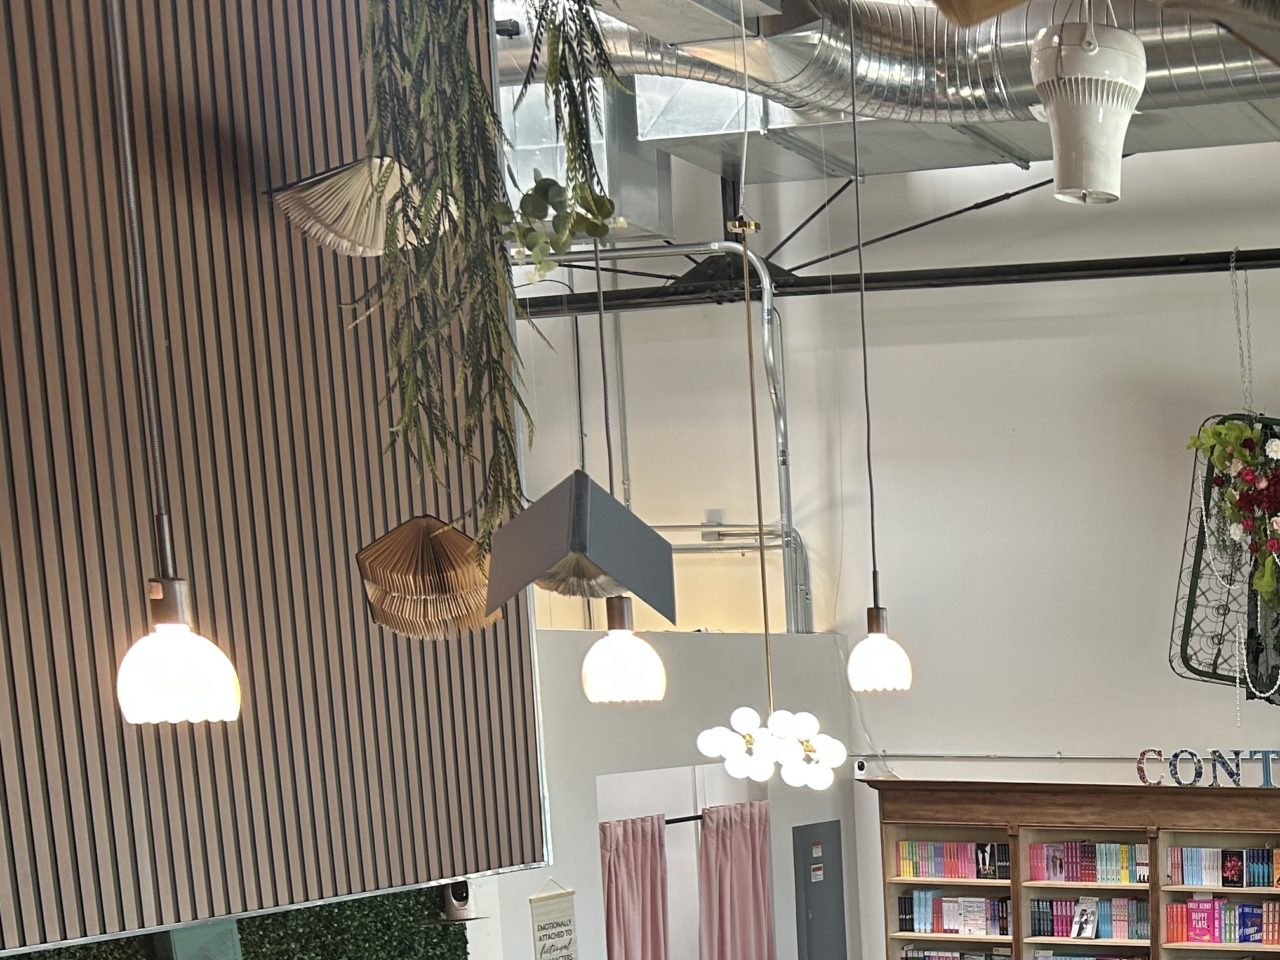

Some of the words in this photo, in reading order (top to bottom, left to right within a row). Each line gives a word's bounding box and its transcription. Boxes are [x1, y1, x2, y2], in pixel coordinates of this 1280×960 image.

[1192, 912, 1208, 920] HAPPY
[537, 919, 573, 932] EMOTIONALLY
[1192, 920, 1208, 928] PLACE
[538, 931, 565, 942] ATTACHED
[565, 929, 573, 937] TO
[540, 938, 573, 960] fictional
